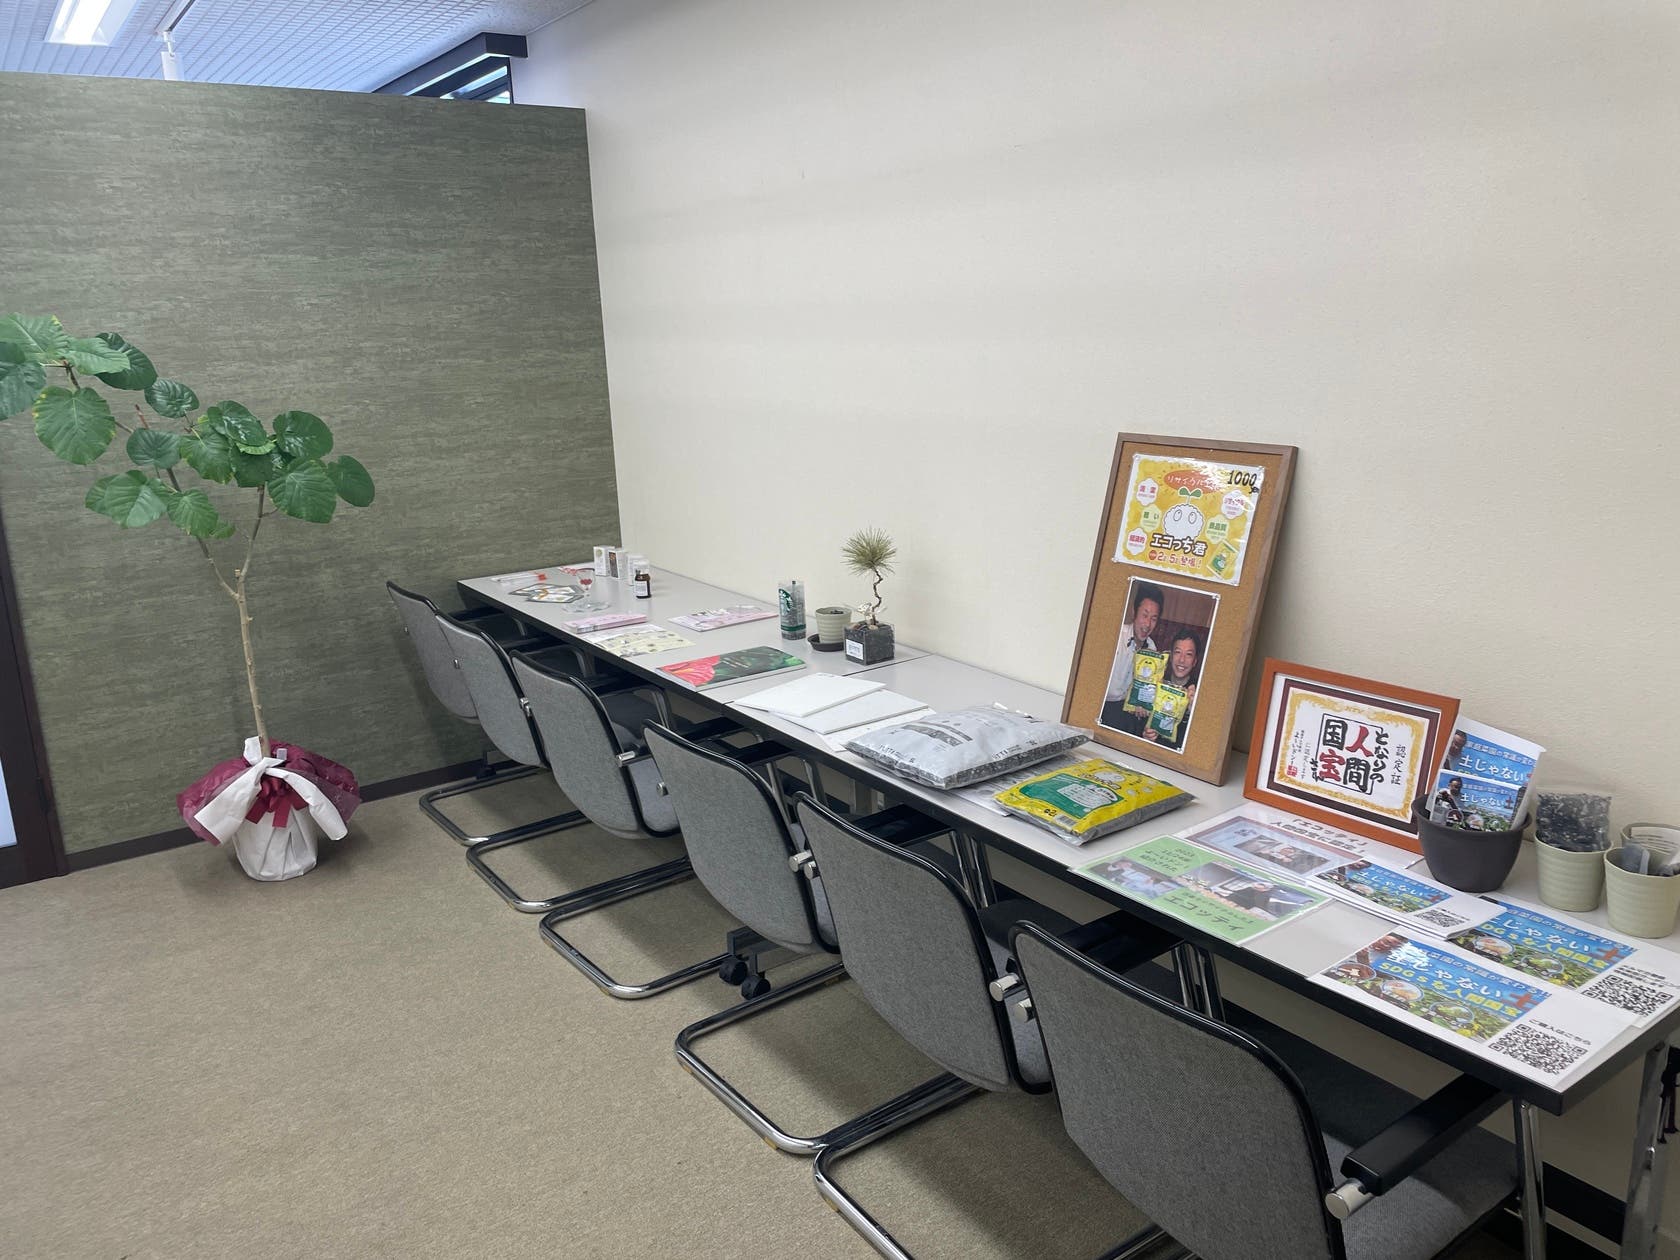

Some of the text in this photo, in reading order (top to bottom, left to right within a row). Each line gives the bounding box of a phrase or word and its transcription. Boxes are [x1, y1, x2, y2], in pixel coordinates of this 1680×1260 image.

[1227, 469, 1258, 487] 1000
[1150, 532, 1208, 557] エコっち君
[1369, 727, 1390, 784] となりの
[1390, 744, 1407, 786] 認定証
[1458, 754, 1524, 782] 土じゃない
[1163, 895, 1245, 931] エコッティ
[1495, 916, 1592, 953] じゃない
